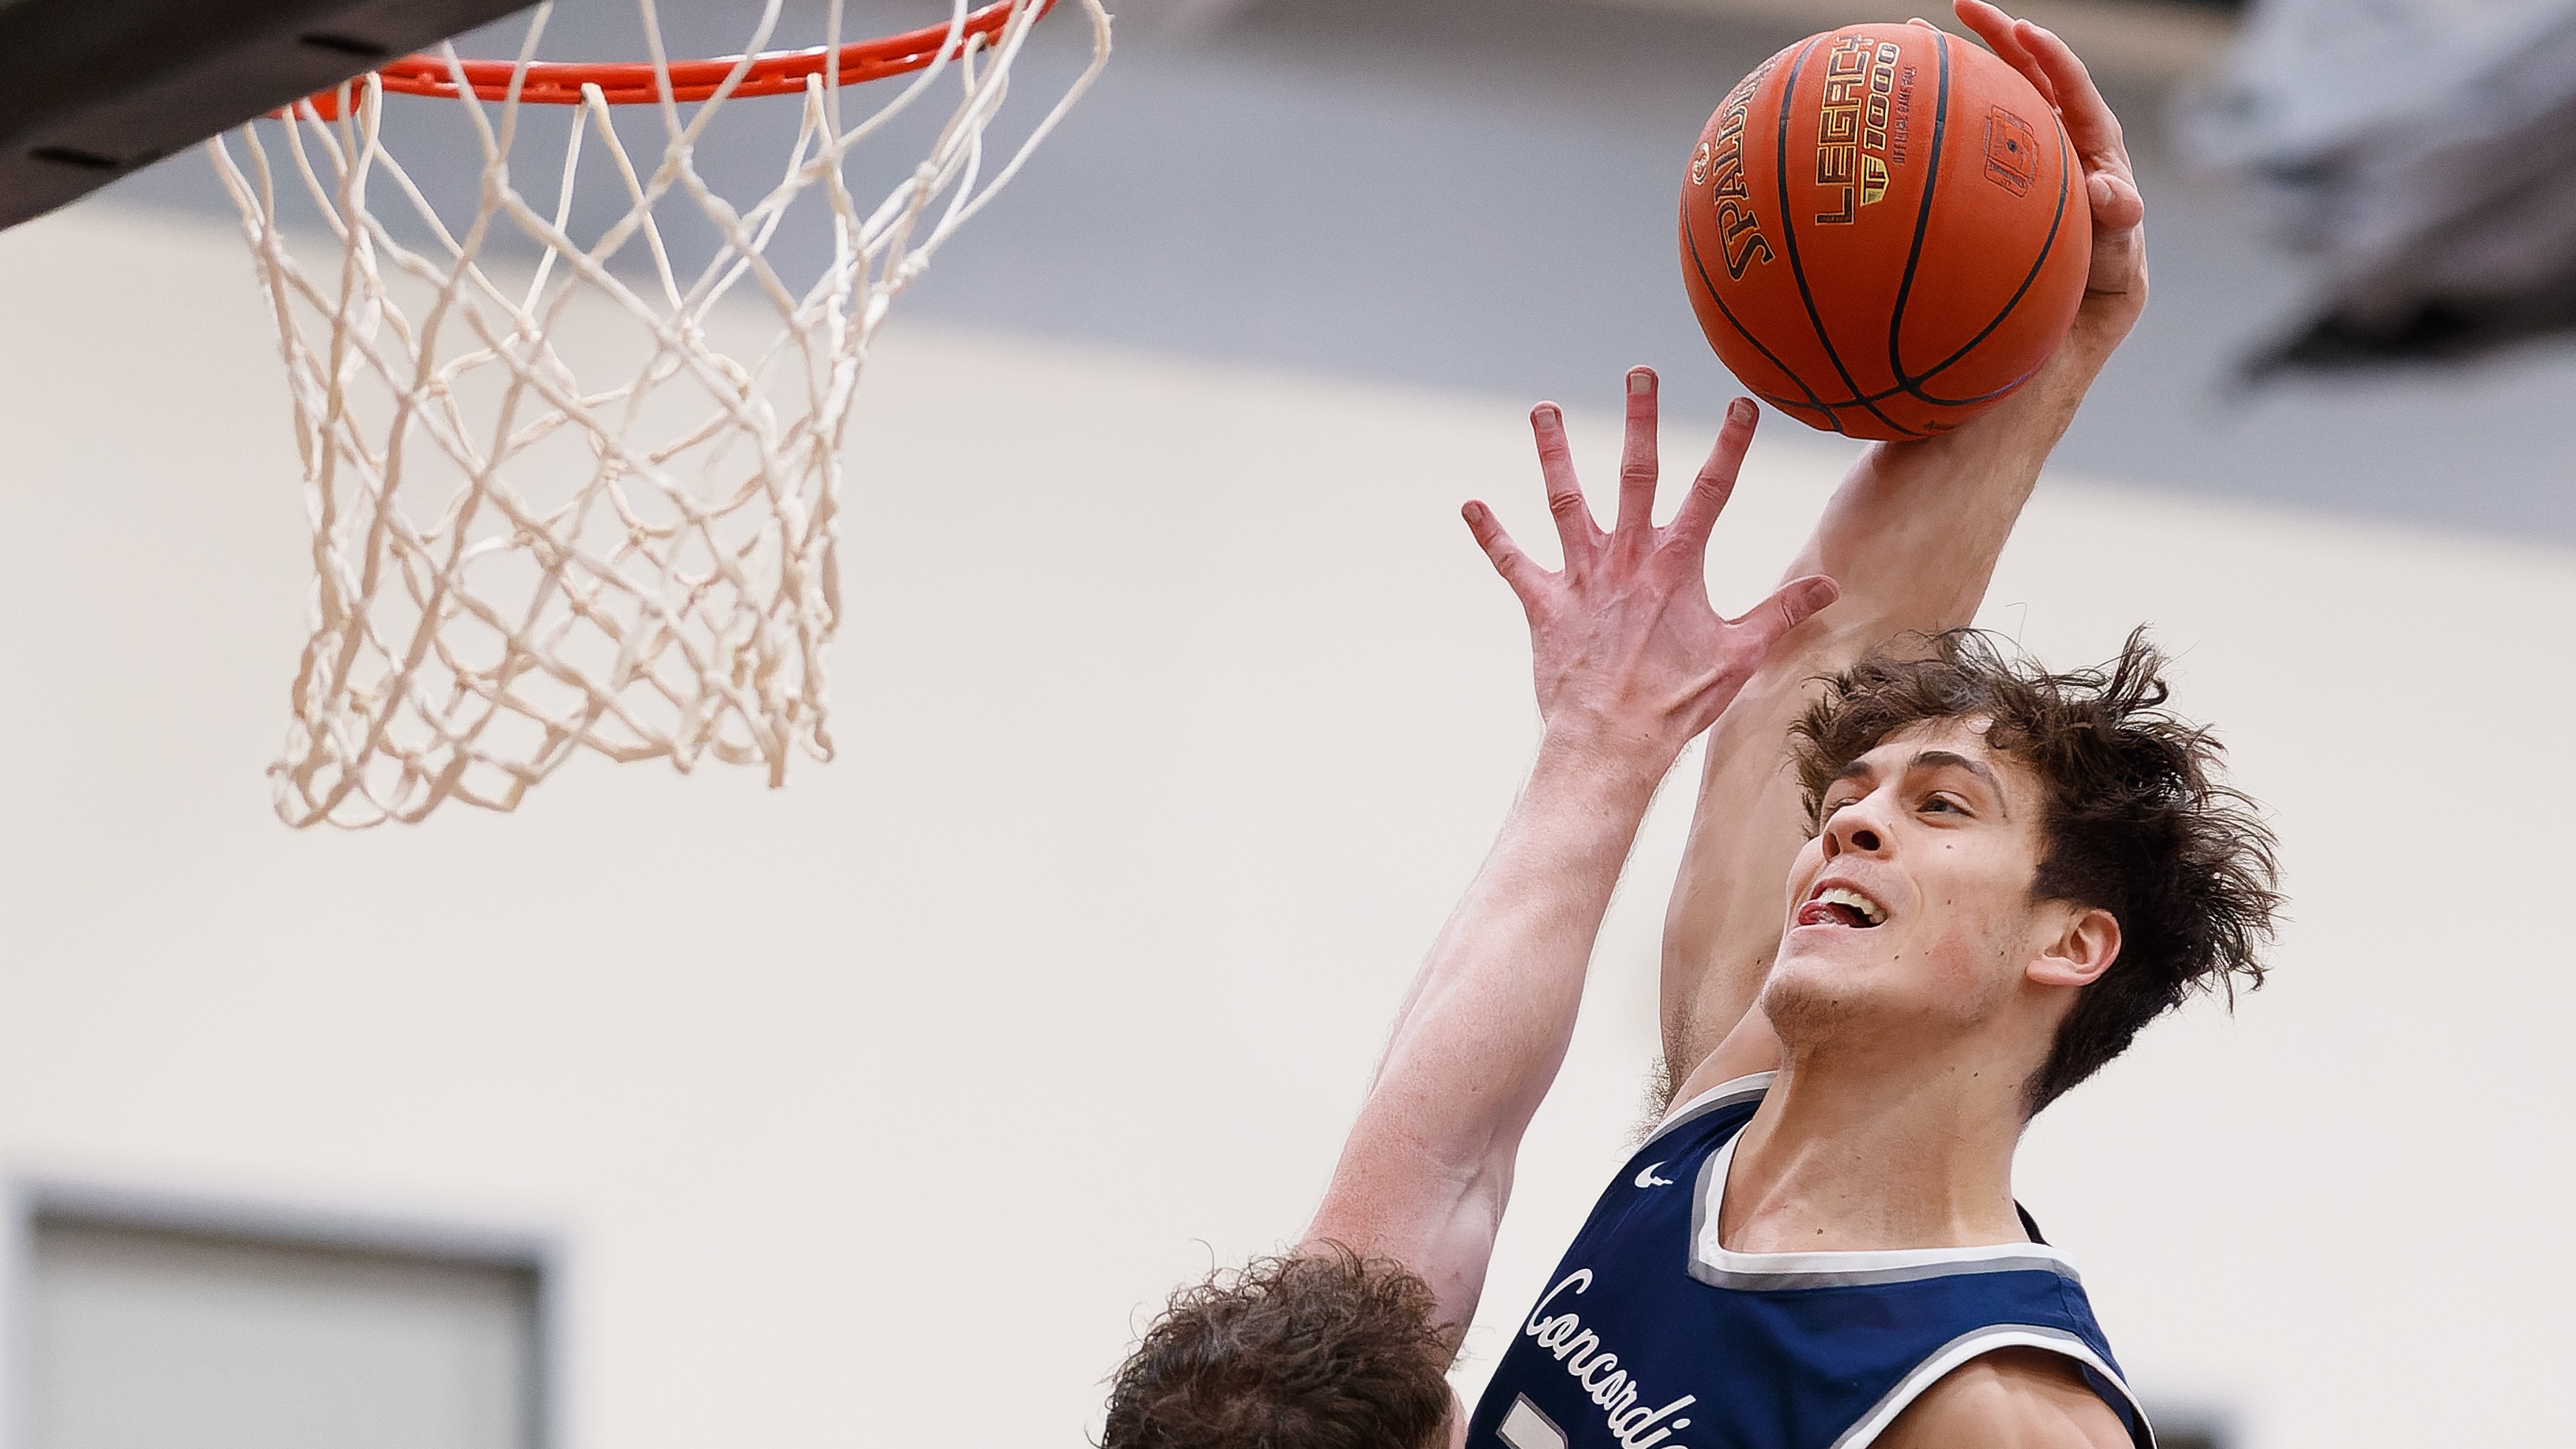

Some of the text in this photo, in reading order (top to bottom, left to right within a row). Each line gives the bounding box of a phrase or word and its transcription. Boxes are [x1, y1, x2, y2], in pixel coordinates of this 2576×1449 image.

[1815, 34, 1874, 226] LEGACY
[1860, 42, 1900, 205] TF 1000
[1526, 1267, 1696, 1449] Concordi
